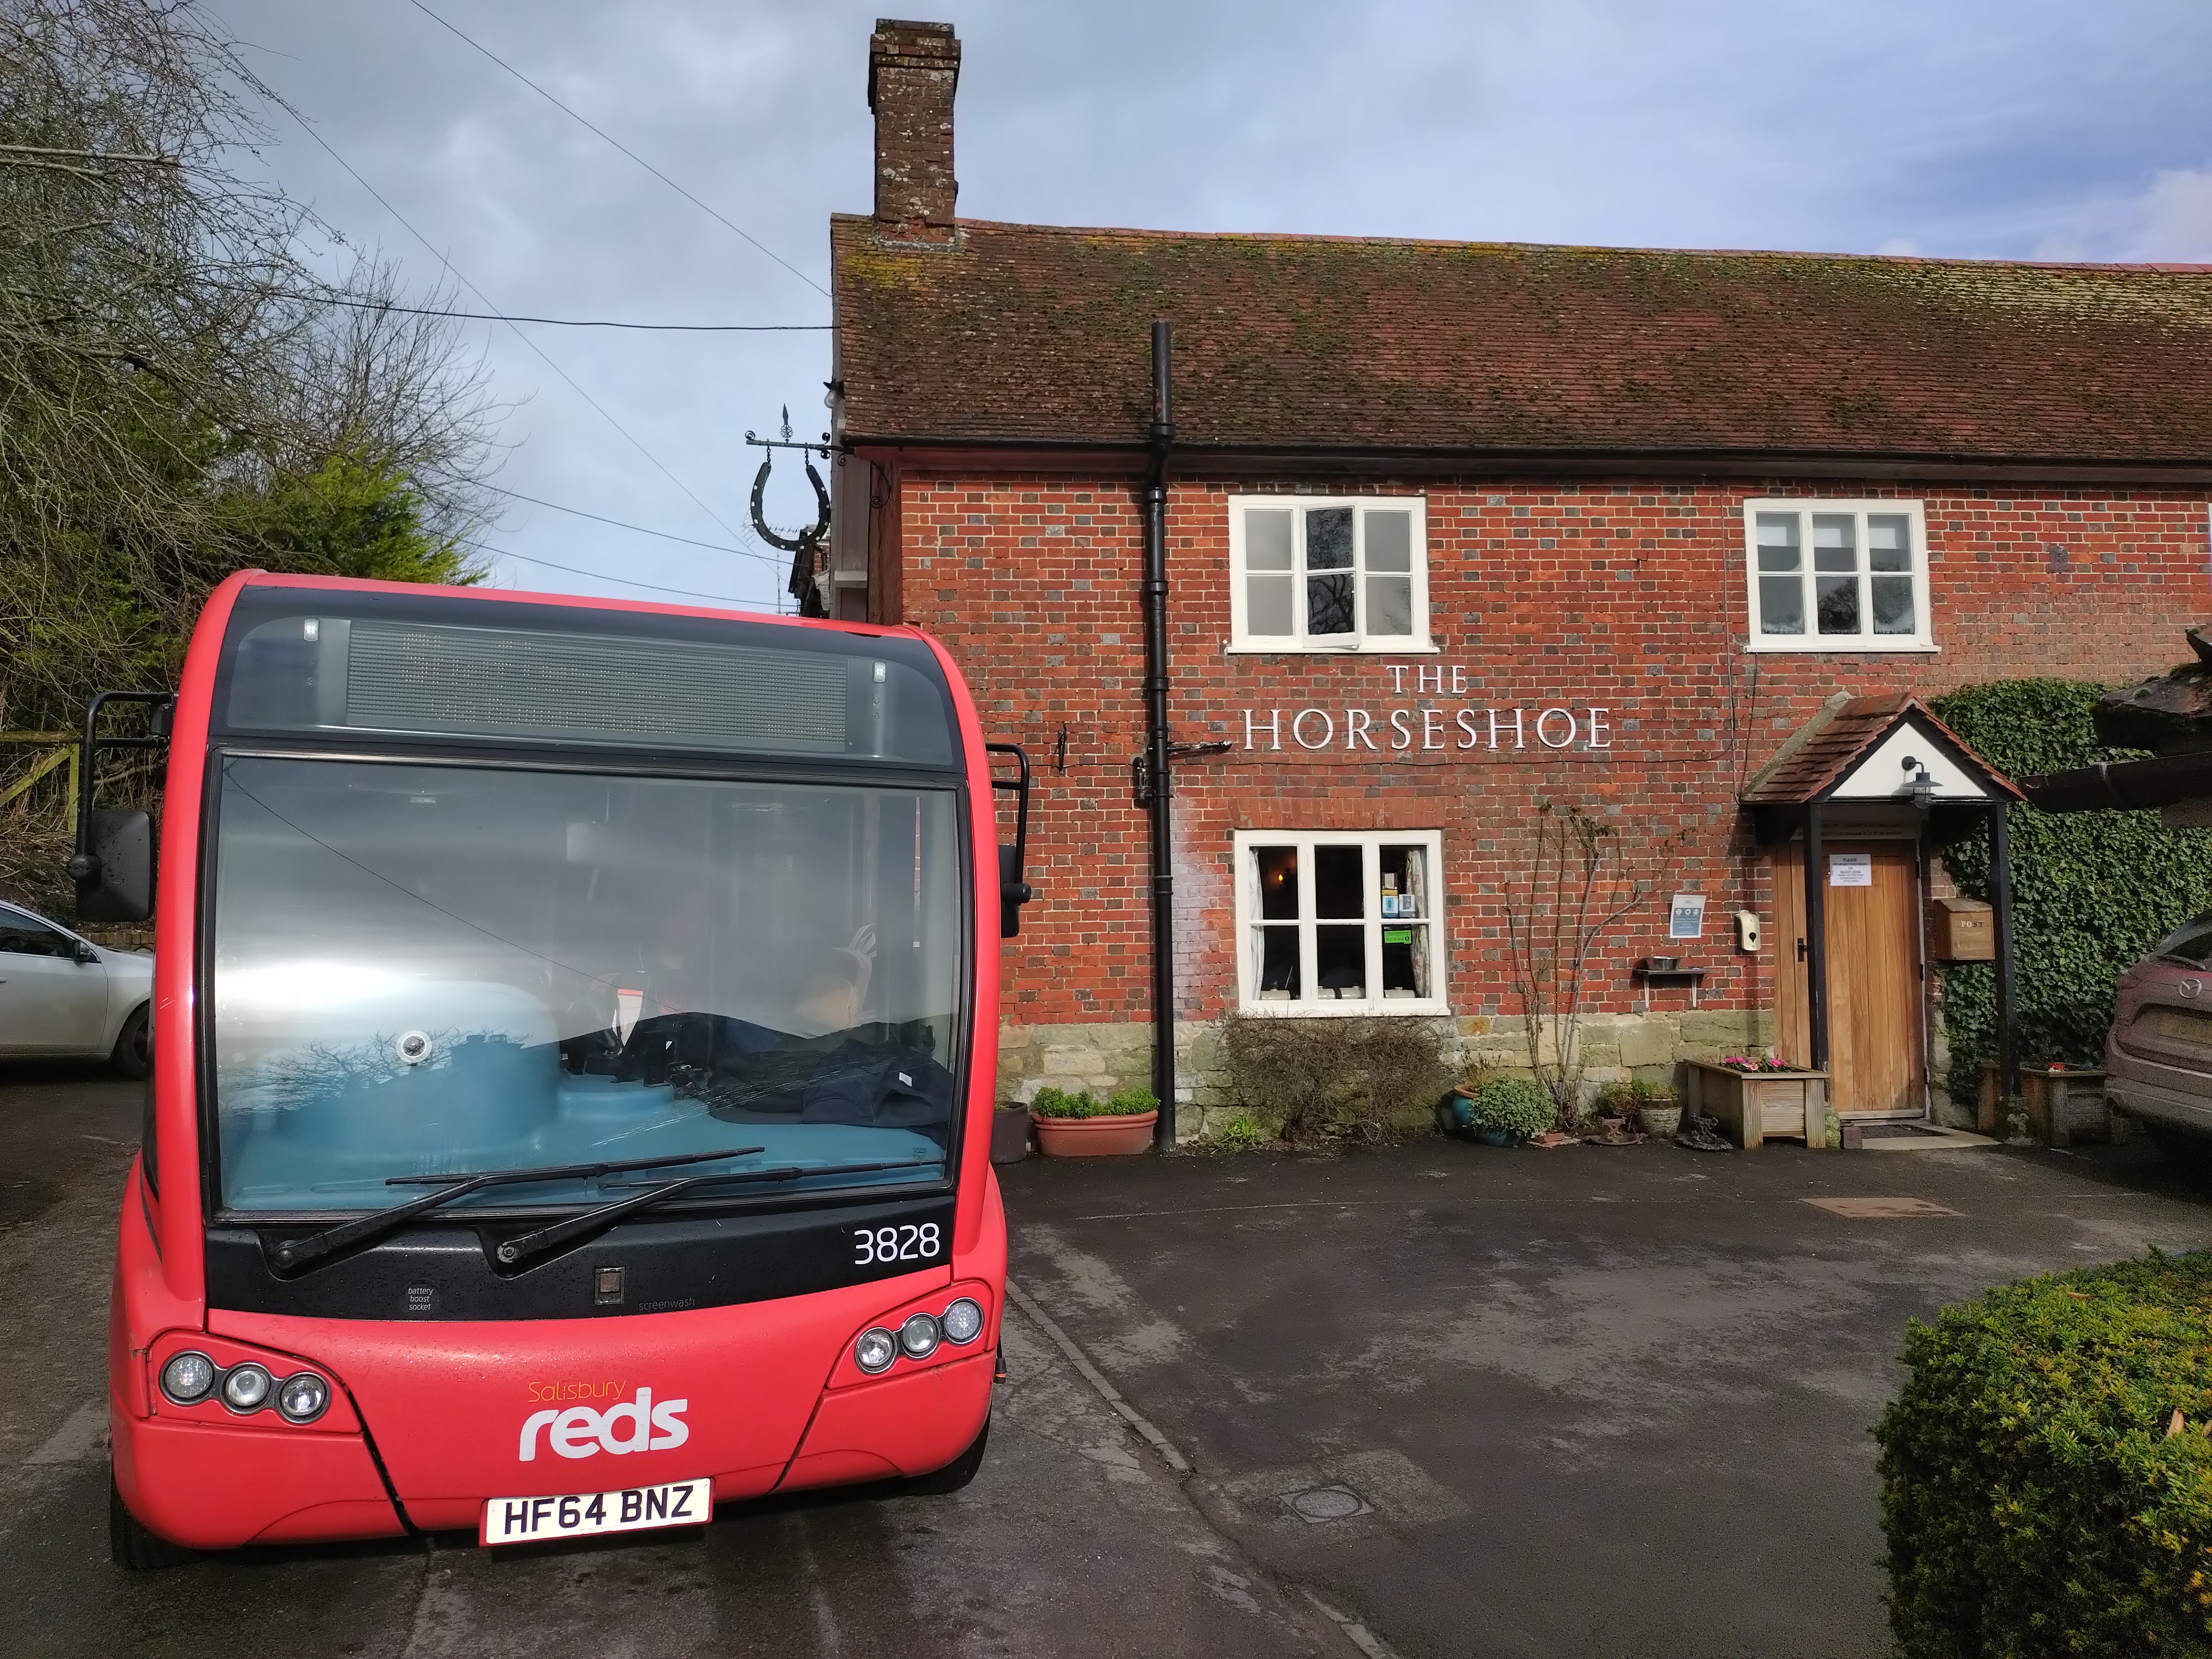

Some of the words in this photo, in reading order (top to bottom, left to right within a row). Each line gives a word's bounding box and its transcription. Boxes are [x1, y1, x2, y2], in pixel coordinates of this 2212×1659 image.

[1386, 665, 1467, 694] THE
[1243, 708, 1611, 750] HORSESHOE
[854, 1223, 940, 1265] 3828
[408, 1287, 433, 1296] battery
[639, 1296, 695, 1311] screenwash
[409, 1303, 431, 1311] socket
[528, 1380, 626, 1402] Salisbury
[519, 1387, 689, 1462] reds
[504, 1494, 606, 1535] HF64
[620, 1485, 694, 1524] BNZ
